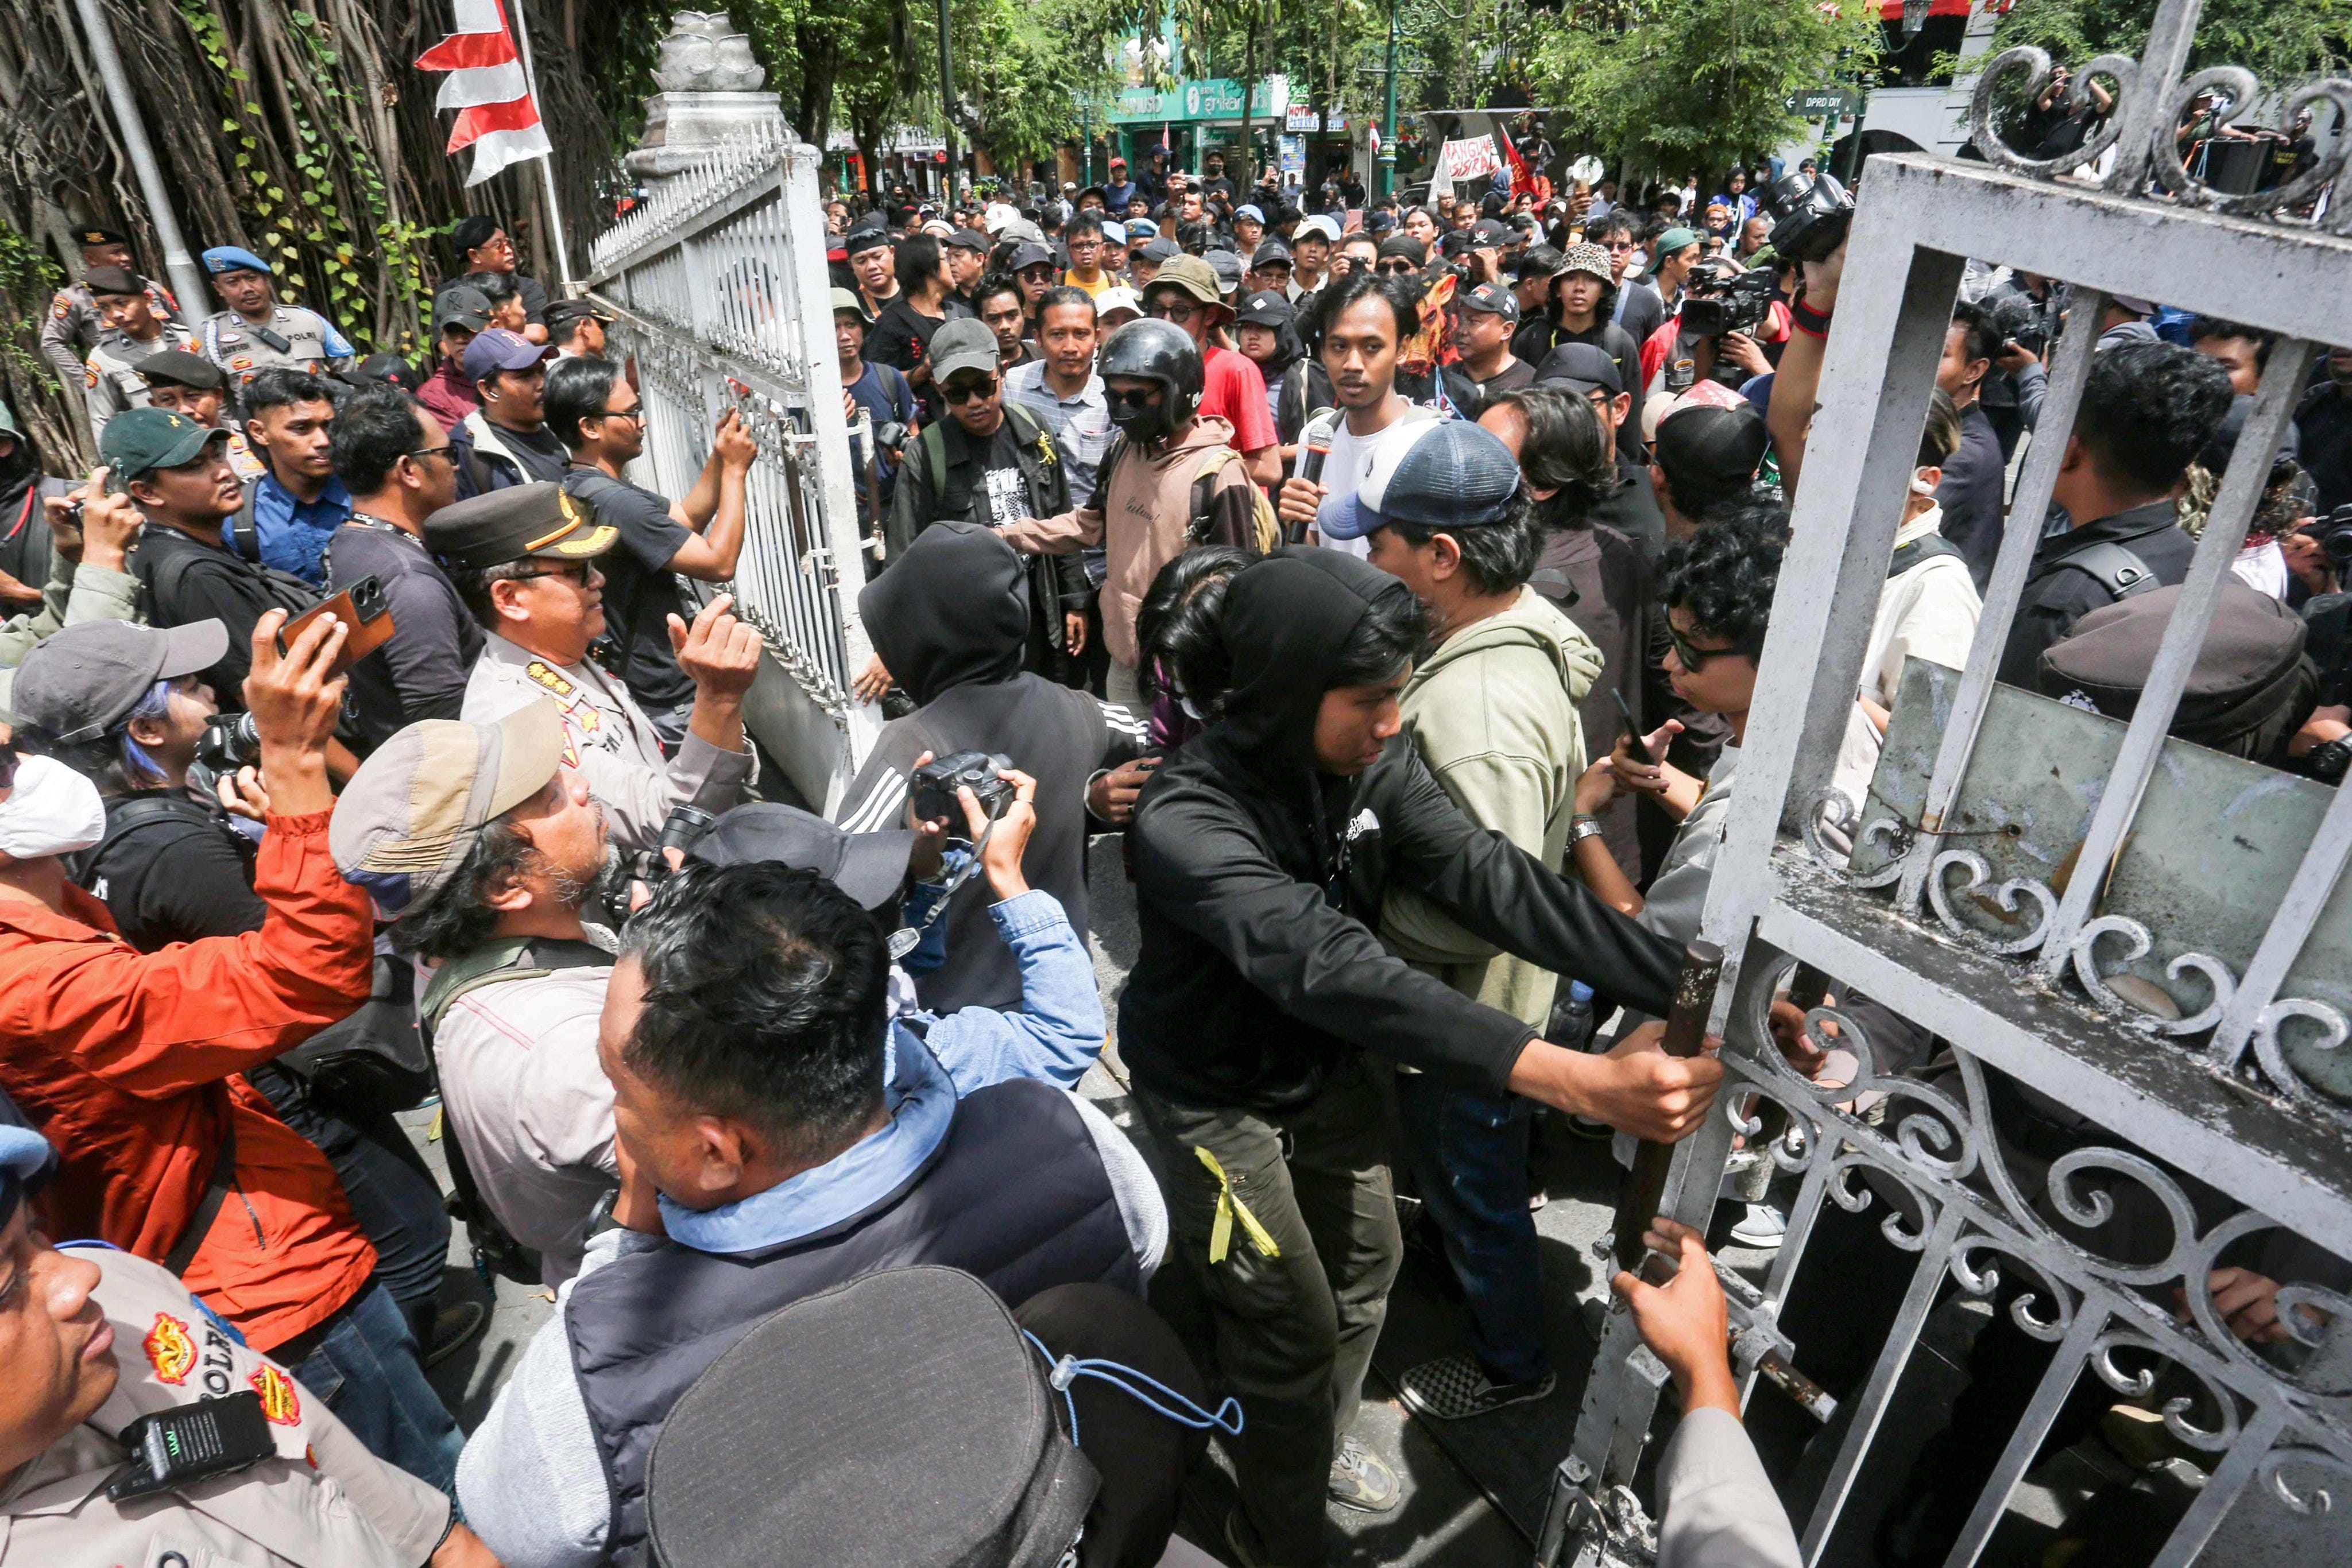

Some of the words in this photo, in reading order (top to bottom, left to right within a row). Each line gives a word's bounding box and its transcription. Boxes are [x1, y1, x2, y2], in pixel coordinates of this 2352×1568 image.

[1805, 97, 1827, 107] DPRD
[1828, 97, 1842, 107] DIY
[288, 331, 315, 342] POLRI
